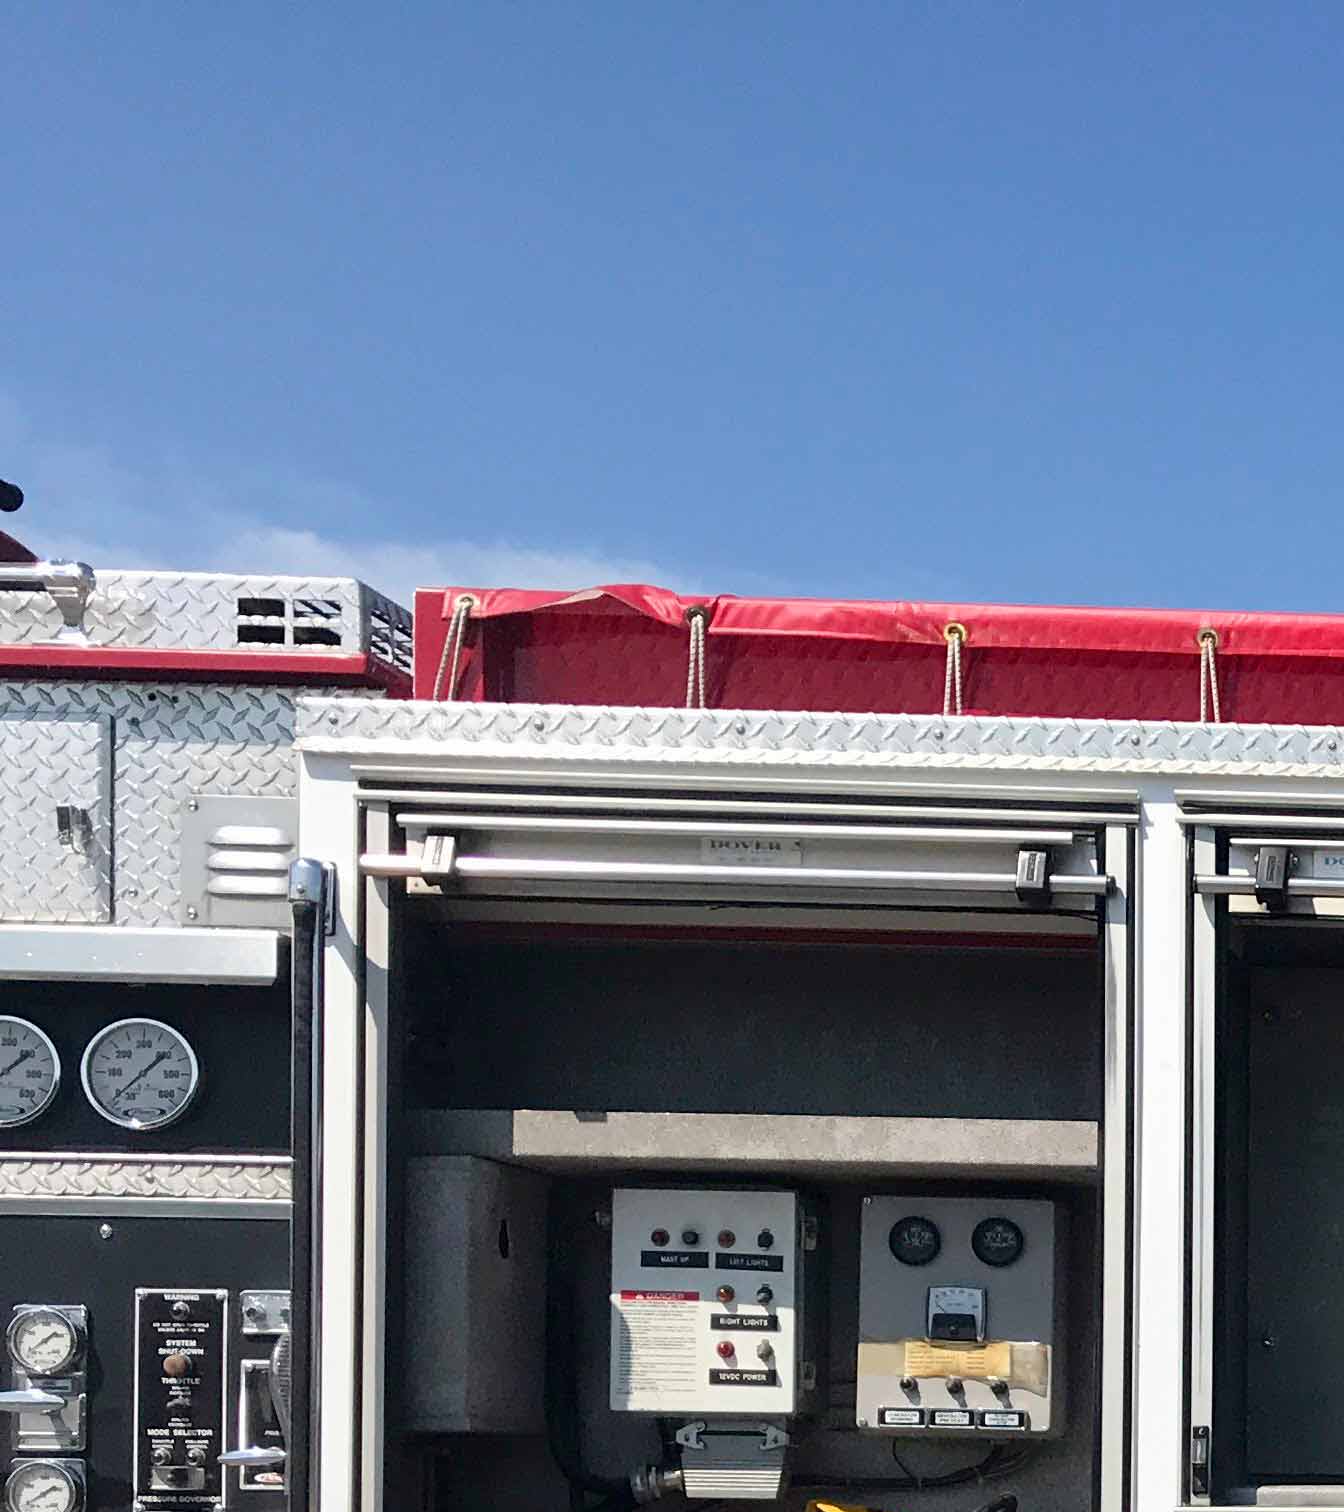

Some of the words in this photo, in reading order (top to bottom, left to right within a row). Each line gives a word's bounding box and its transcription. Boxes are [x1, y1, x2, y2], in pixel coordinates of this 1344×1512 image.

[719, 1317, 740, 1325] RIGHT
[742, 1318, 769, 1326] LIGHTS
[165, 1339, 197, 1347] SYSTEM
[742, 1373, 767, 1381] POWER
